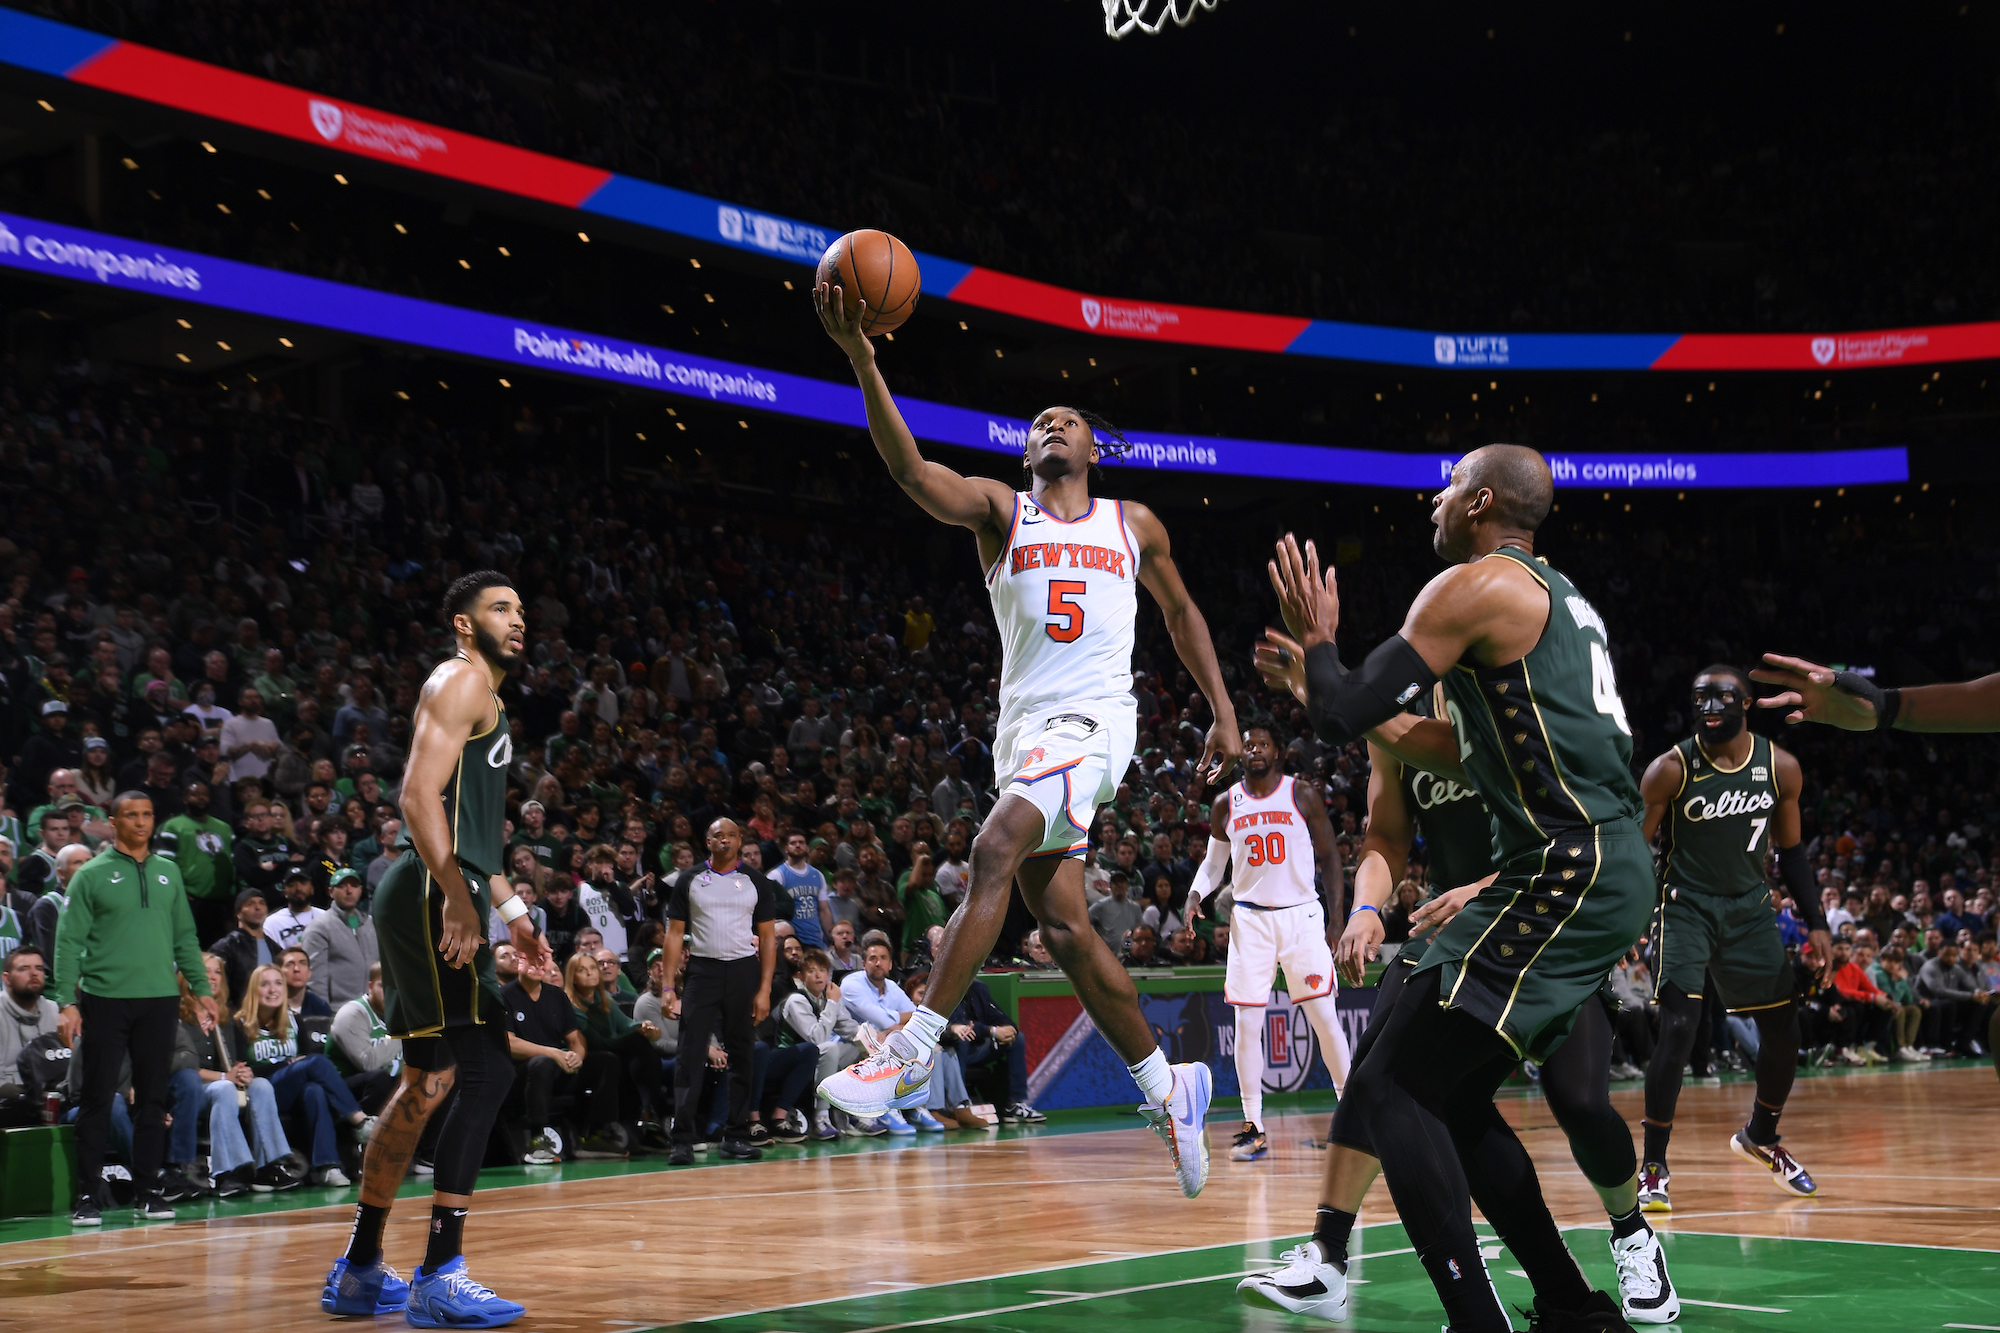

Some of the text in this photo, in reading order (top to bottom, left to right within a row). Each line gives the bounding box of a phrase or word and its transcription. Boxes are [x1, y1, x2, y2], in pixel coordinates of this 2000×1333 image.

[24, 235, 201, 291] companies
[1457, 336, 1509, 353] TUFTS
[664, 363, 777, 402] companies
[1582, 458, 1697, 486] companies
[1010, 543, 1125, 580] NEW YORK
[1045, 579, 1086, 643] 5
[1590, 641, 1633, 737] 4
[1446, 700, 1474, 763] 2
[1751, 766, 1768, 775] VISTA
[1751, 774, 1768, 782] PRINT
[1233, 810, 1293, 832] NEW YORK
[1684, 790, 1774, 822] Celtics
[1245, 832, 1285, 867] 30
[1746, 817, 1768, 852] 7
[799, 896, 815, 909] 33
[600, 915, 607, 927] 0
[253, 1038, 298, 1062] BOSTON
[1218, 1025, 1234, 1056] VS
